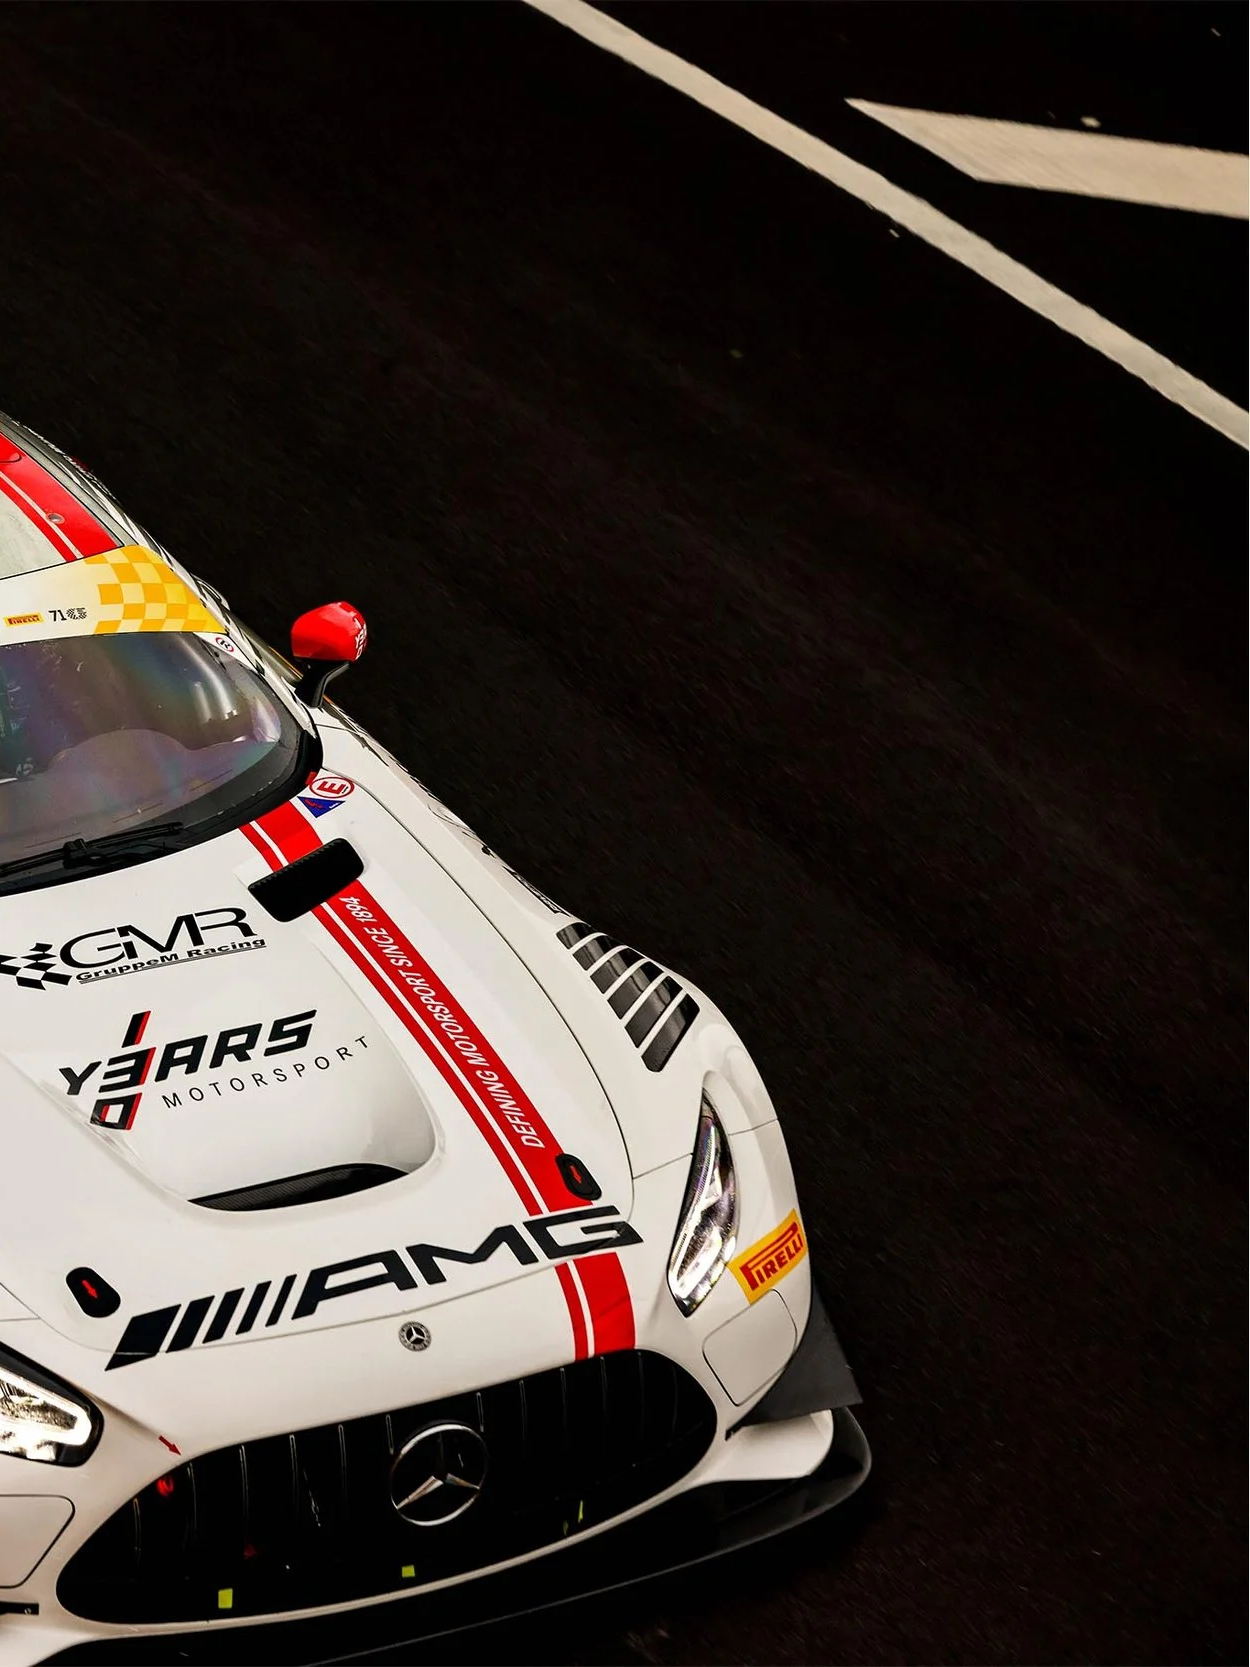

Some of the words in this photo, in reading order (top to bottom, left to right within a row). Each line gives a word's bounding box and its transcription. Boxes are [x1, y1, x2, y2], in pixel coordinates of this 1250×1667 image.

[59, 906, 259, 969] GMR
[340, 896, 378, 924] 1894
[76, 953, 179, 983] GruppeM
[186, 937, 266, 959] Racing
[364, 921, 414, 970] SINCE
[397, 964, 490, 1069] MOTORSPORT
[162, 1035, 370, 1109] MOTORSPORT
[475, 1067, 545, 1150] DEFINING
[291, 1205, 643, 1319] AMG
[740, 1222, 804, 1291] PIRELLI
